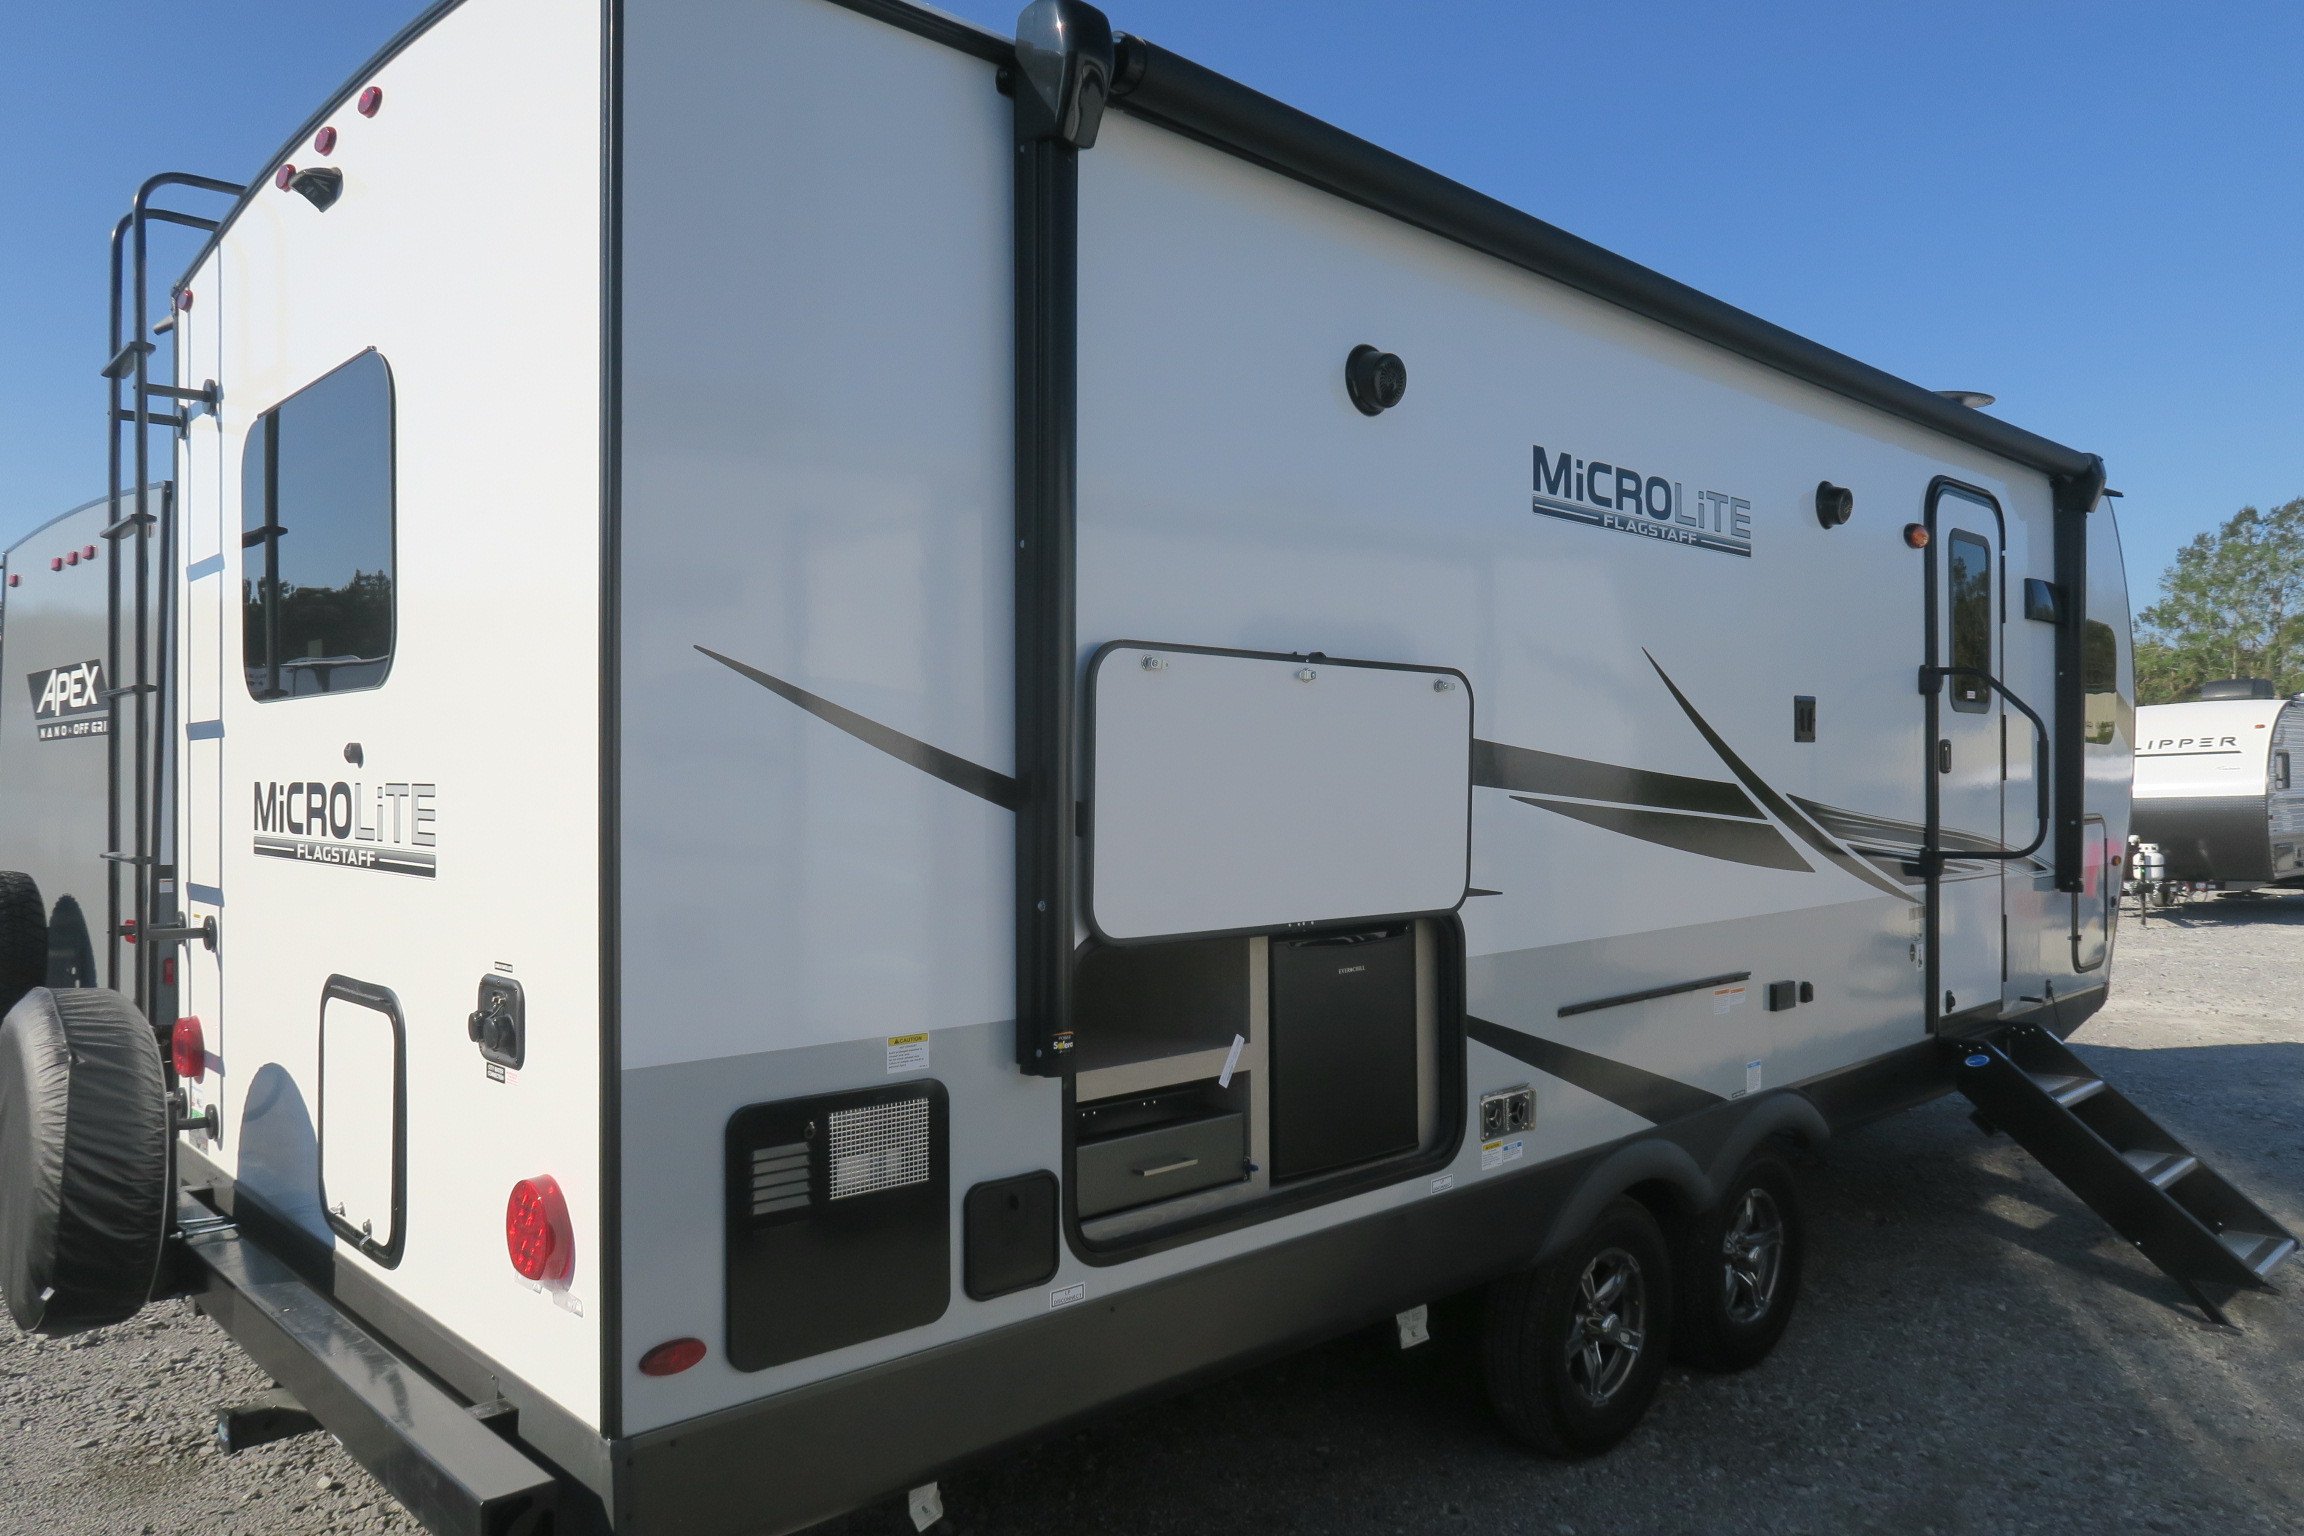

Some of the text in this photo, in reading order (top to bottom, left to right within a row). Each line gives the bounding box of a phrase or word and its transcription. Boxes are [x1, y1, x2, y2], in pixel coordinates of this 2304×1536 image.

[1603, 513, 1698, 545] FLAGSTAFF
[36, 662, 99, 717] APEX
[40, 720, 108, 739] NANO OFF GRI
[297, 843, 376, 867] FLAGSTAFF
[900, 1035, 922, 1044] CAUTION
